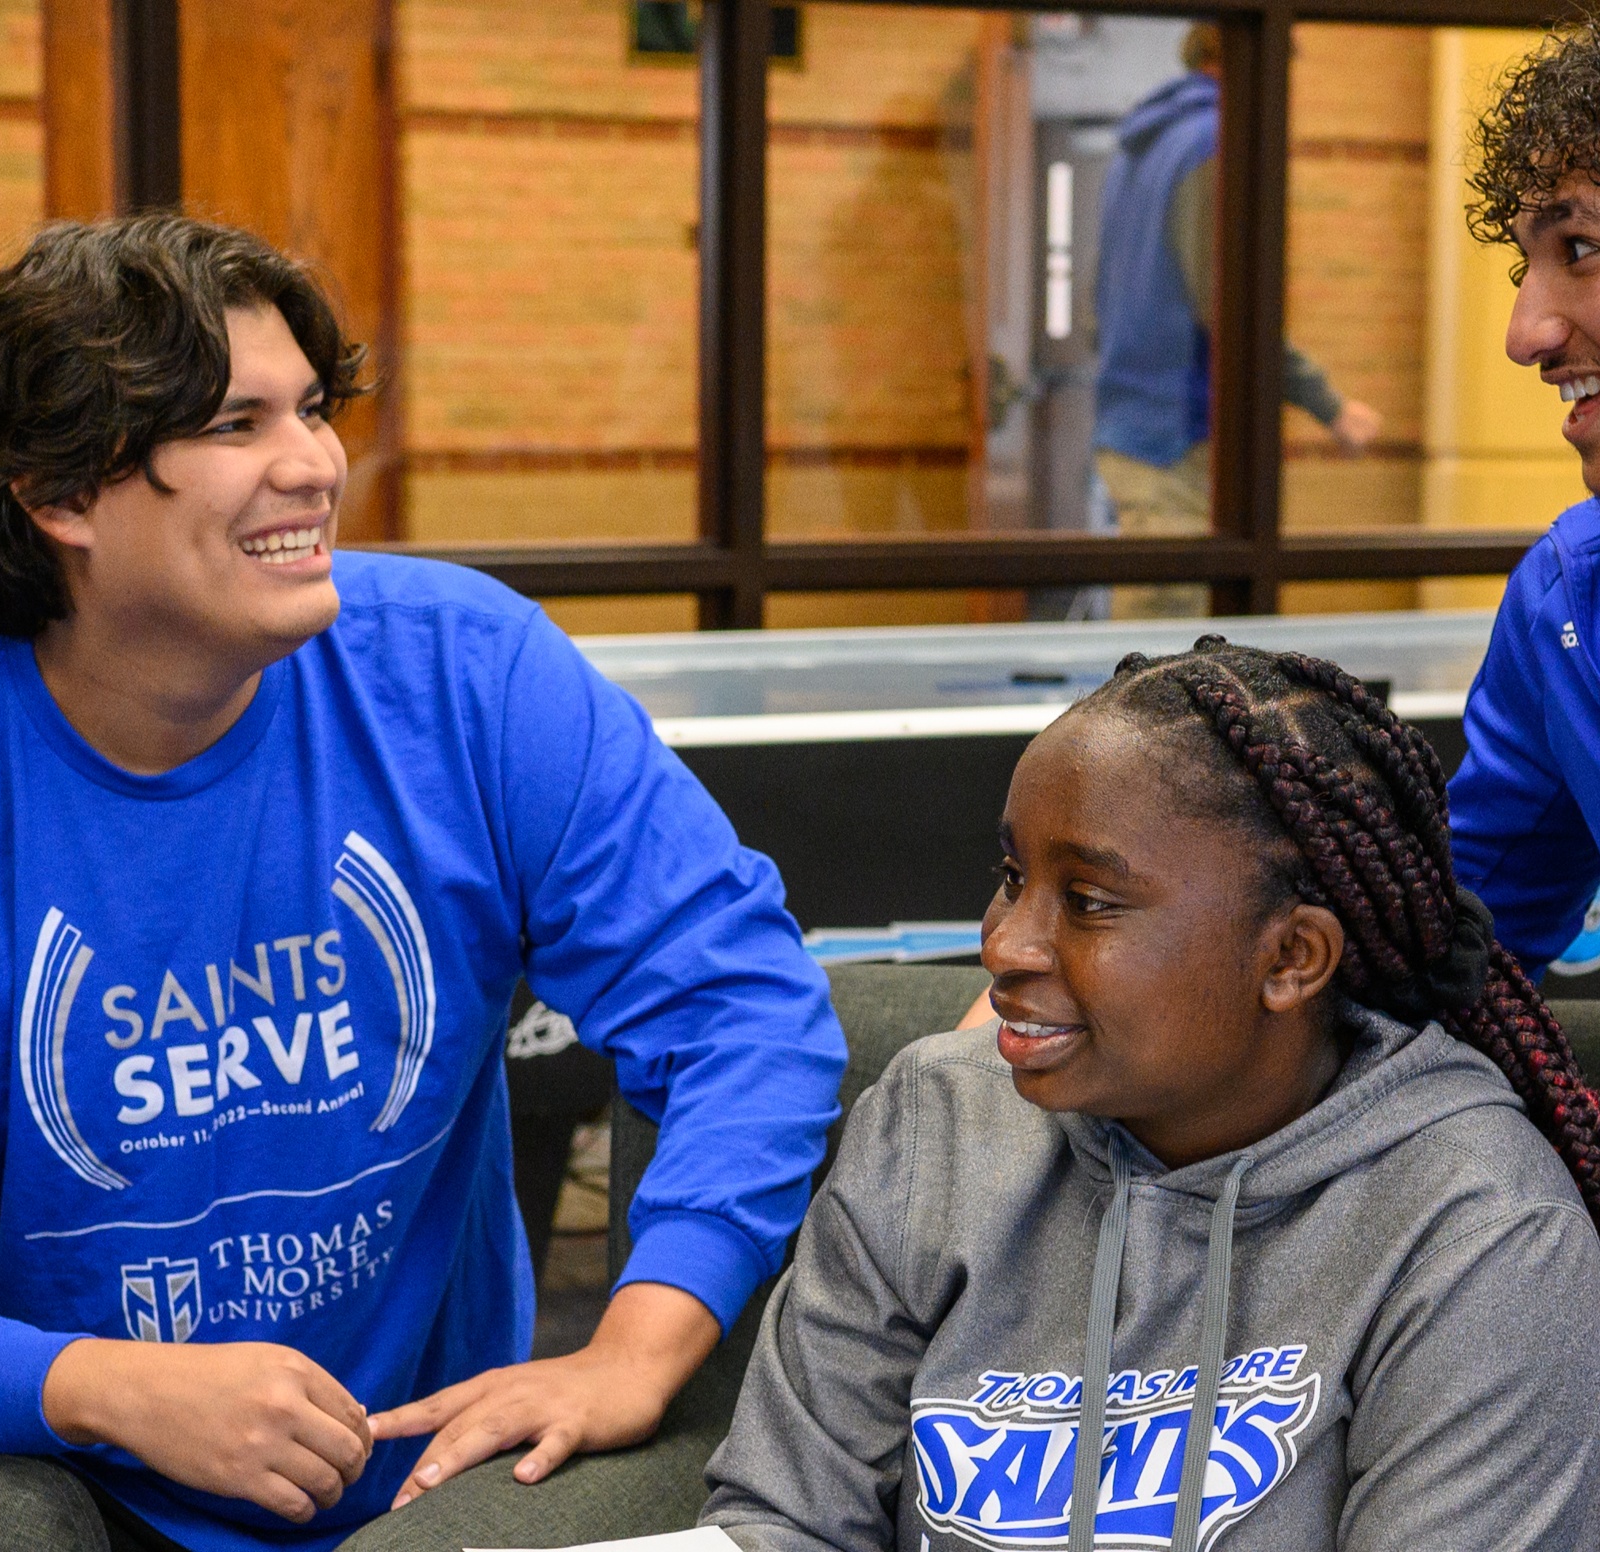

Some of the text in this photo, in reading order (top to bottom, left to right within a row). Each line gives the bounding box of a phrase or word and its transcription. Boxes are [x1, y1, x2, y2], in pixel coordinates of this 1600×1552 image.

[102, 929, 346, 1049] SAINTS
[114, 1000, 359, 1124] SERVE
[120, 1132, 186, 1154] October
[317, 1080, 364, 1114] Annual
[208, 1200, 393, 1270] THOMAS
[242, 1240, 370, 1298] MORE
[208, 1246, 394, 1324] UNIVERSITY
[1166, 1346, 1305, 1396] MORE
[912, 1396, 1306, 1525] SAINTS
